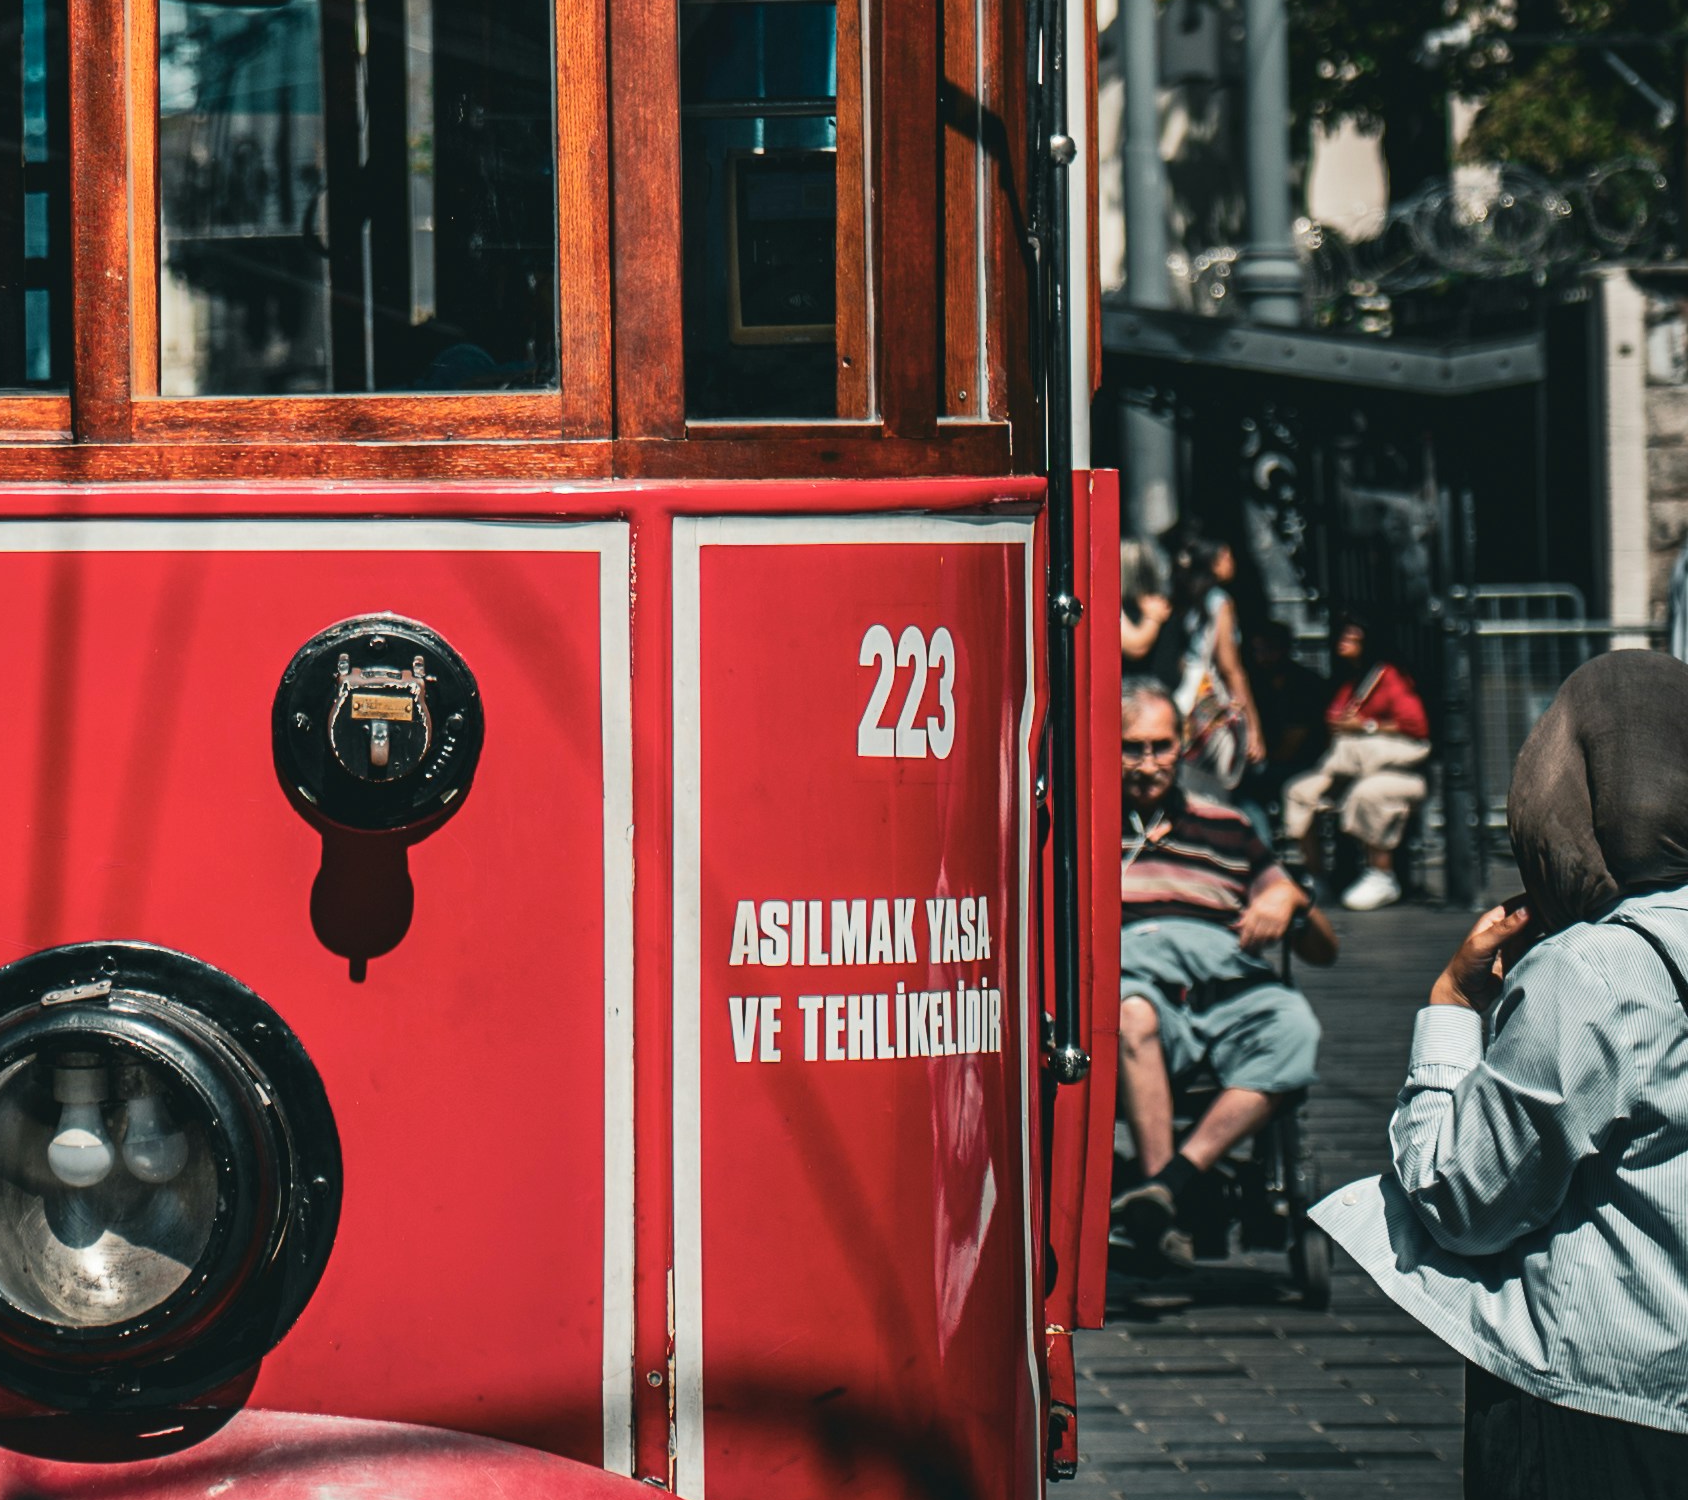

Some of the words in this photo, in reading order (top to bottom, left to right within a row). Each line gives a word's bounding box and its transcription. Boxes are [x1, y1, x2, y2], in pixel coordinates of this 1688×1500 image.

[857, 624, 956, 760] 223
[728, 898, 918, 967] ASILMAK
[728, 996, 782, 1063] VE
[798, 978, 1002, 1062] TEHLİKELİDİR
